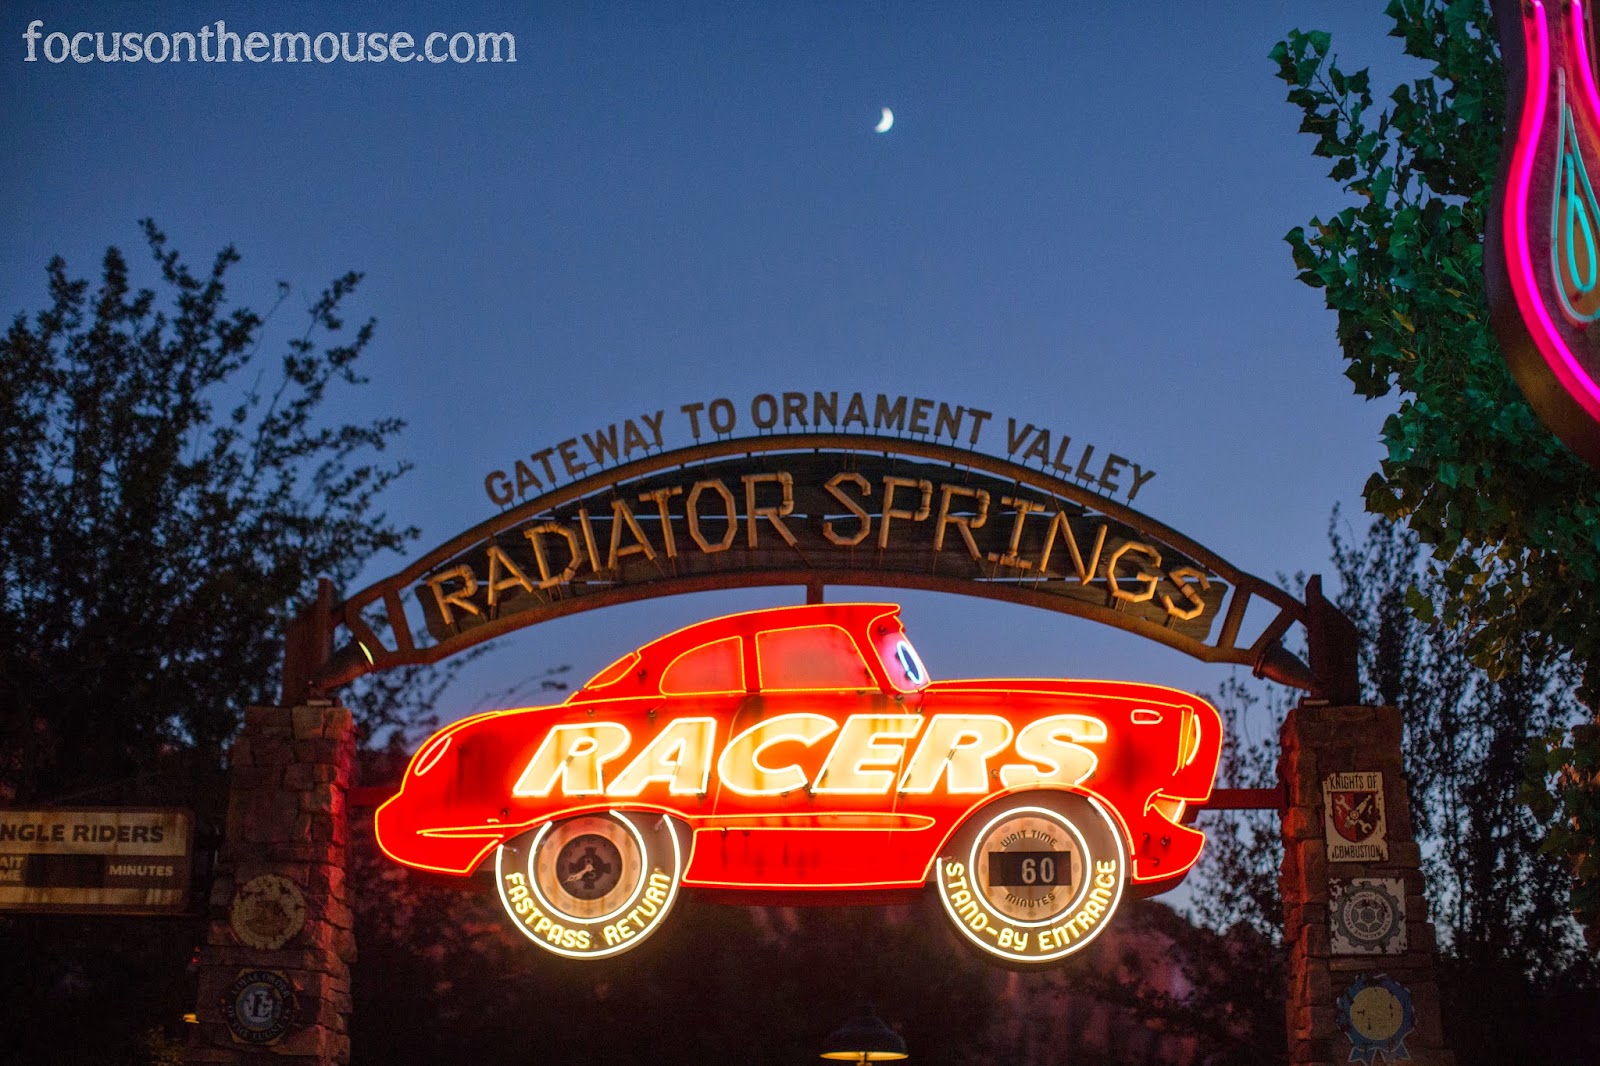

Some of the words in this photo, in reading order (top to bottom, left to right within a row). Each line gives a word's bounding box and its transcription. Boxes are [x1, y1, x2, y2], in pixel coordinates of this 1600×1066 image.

[484, 410, 665, 506] GATEWAY
[681, 398, 737, 439] TO
[751, 391, 992, 444] ORNAMENT
[1008, 417, 1157, 501] VALLEY
[425, 471, 800, 626] RADIATOR
[822, 472, 1211, 621] SPRINGS
[511, 712, 1108, 797] RACERS
[1330, 774, 1364, 789] KNIGHTS
[1367, 774, 1377, 788] OF
[72, 824, 164, 843] RIDERS
[1000, 830, 1027, 847] WAIT
[1031, 830, 1058, 847] TIME
[1334, 845, 1381, 859] COMBUSTION
[108, 865, 174, 877] MINUTES
[1021, 857, 1055, 884] 60
[505, 872, 591, 949] FASTPASS
[603, 872, 671, 946] RETURN
[945, 861, 1029, 951] STAND-BY
[1038, 858, 1117, 951] ENTRANCE
[1005, 892, 1056, 908] MINUTES
